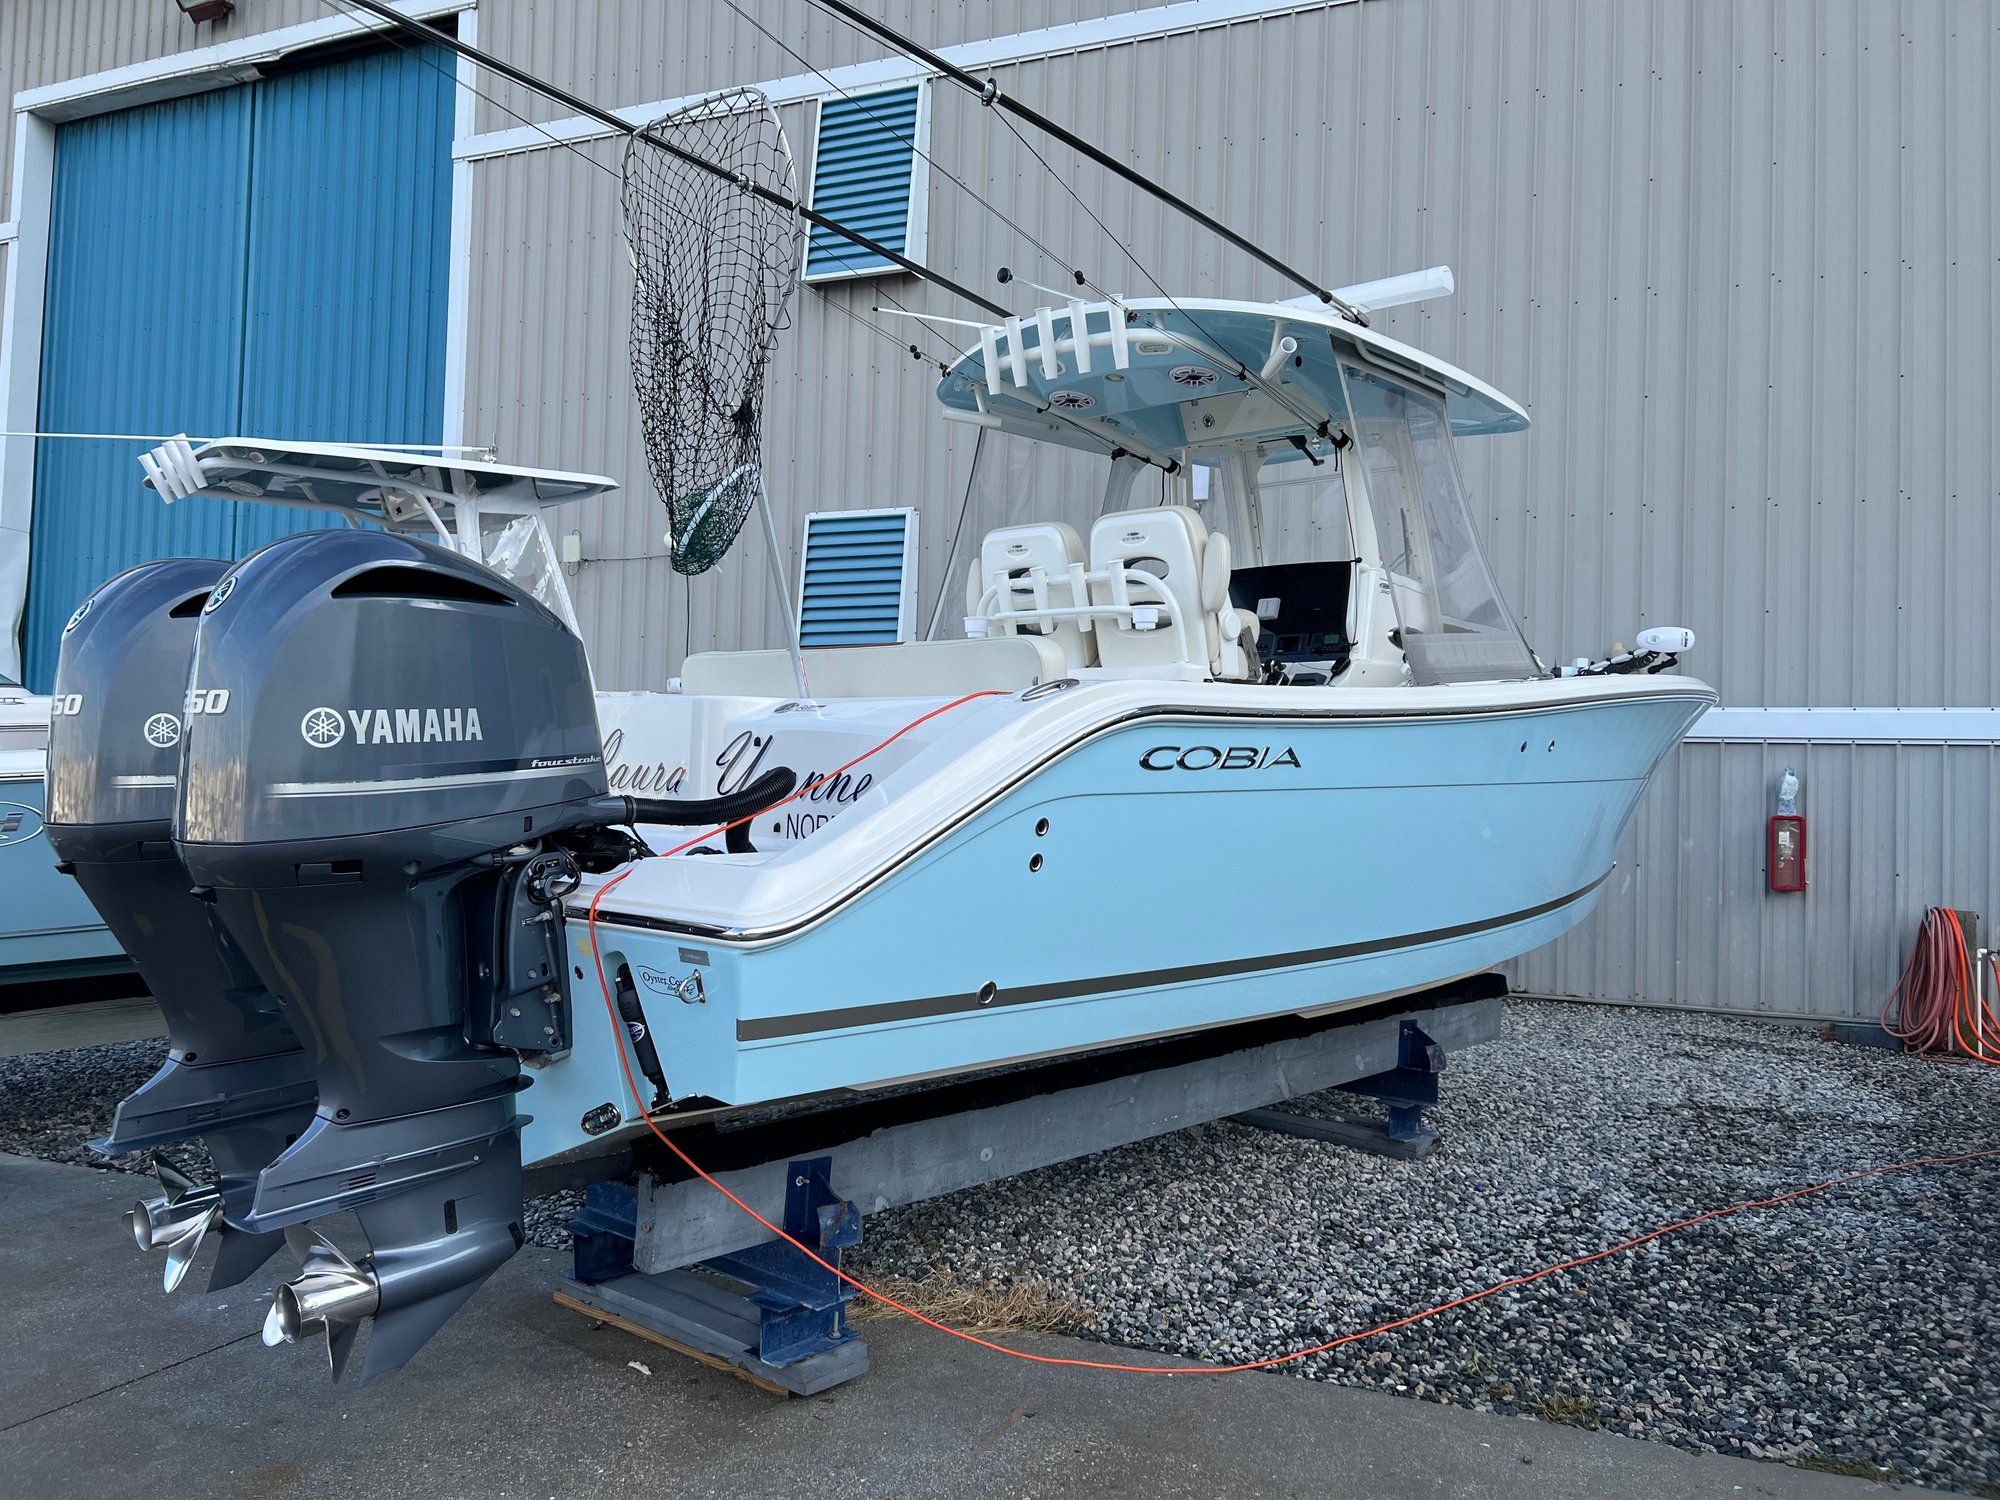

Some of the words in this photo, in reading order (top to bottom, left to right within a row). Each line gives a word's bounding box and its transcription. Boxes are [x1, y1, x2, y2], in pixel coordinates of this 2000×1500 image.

[348, 707, 484, 745] YAMAHA
[715, 730, 873, 803] Ynne
[1138, 745, 1302, 771] COBIA
[642, 971, 669, 986] Oyster
